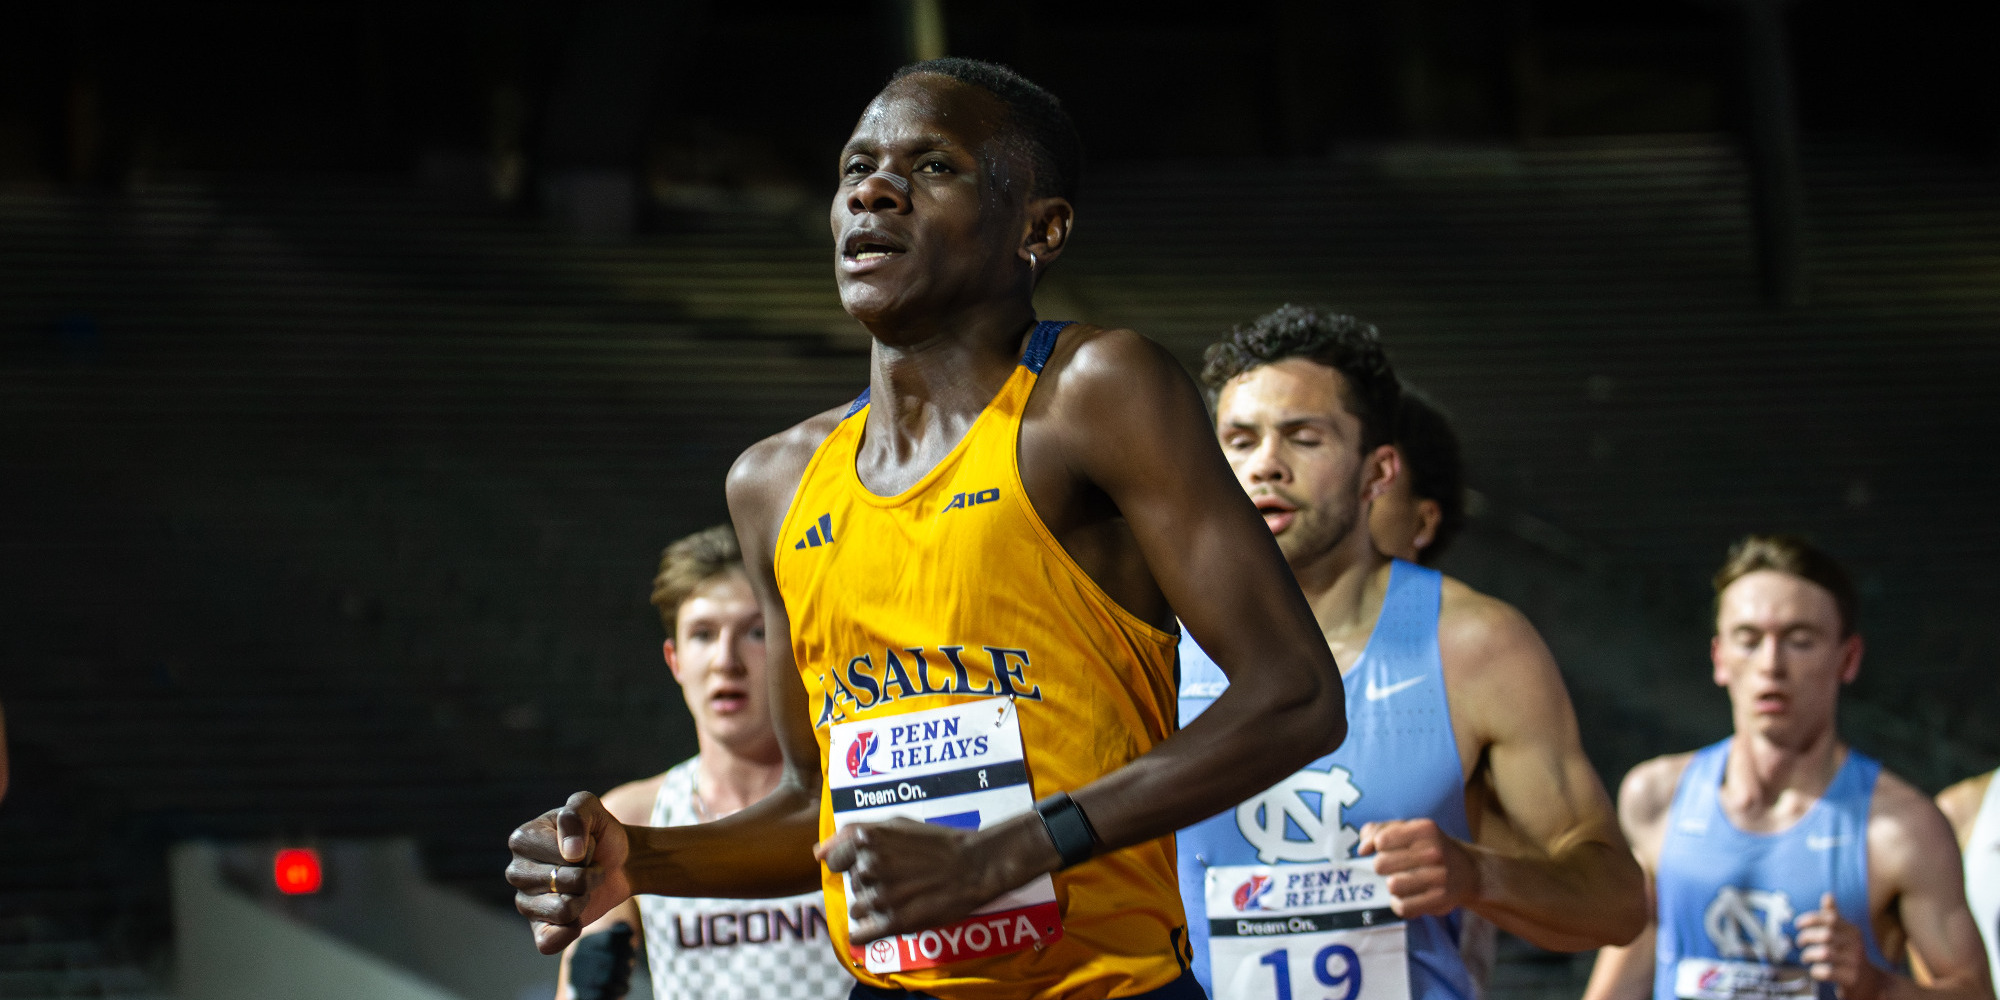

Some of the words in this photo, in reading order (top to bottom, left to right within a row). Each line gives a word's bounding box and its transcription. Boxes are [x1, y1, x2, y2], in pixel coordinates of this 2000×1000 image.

[942, 487, 1000, 513] A10
[890, 716, 960, 746] PENN
[891, 735, 989, 770] RELAYS
[854, 786, 896, 808] Dream
[898, 782, 927, 802] On.
[1287, 868, 1352, 890] PENN
[1285, 883, 1376, 907] RELAYS
[900, 915, 1040, 962] TOYOTA
[1236, 920, 1287, 936] Dream
[1260, 944, 1362, 1000] 19
